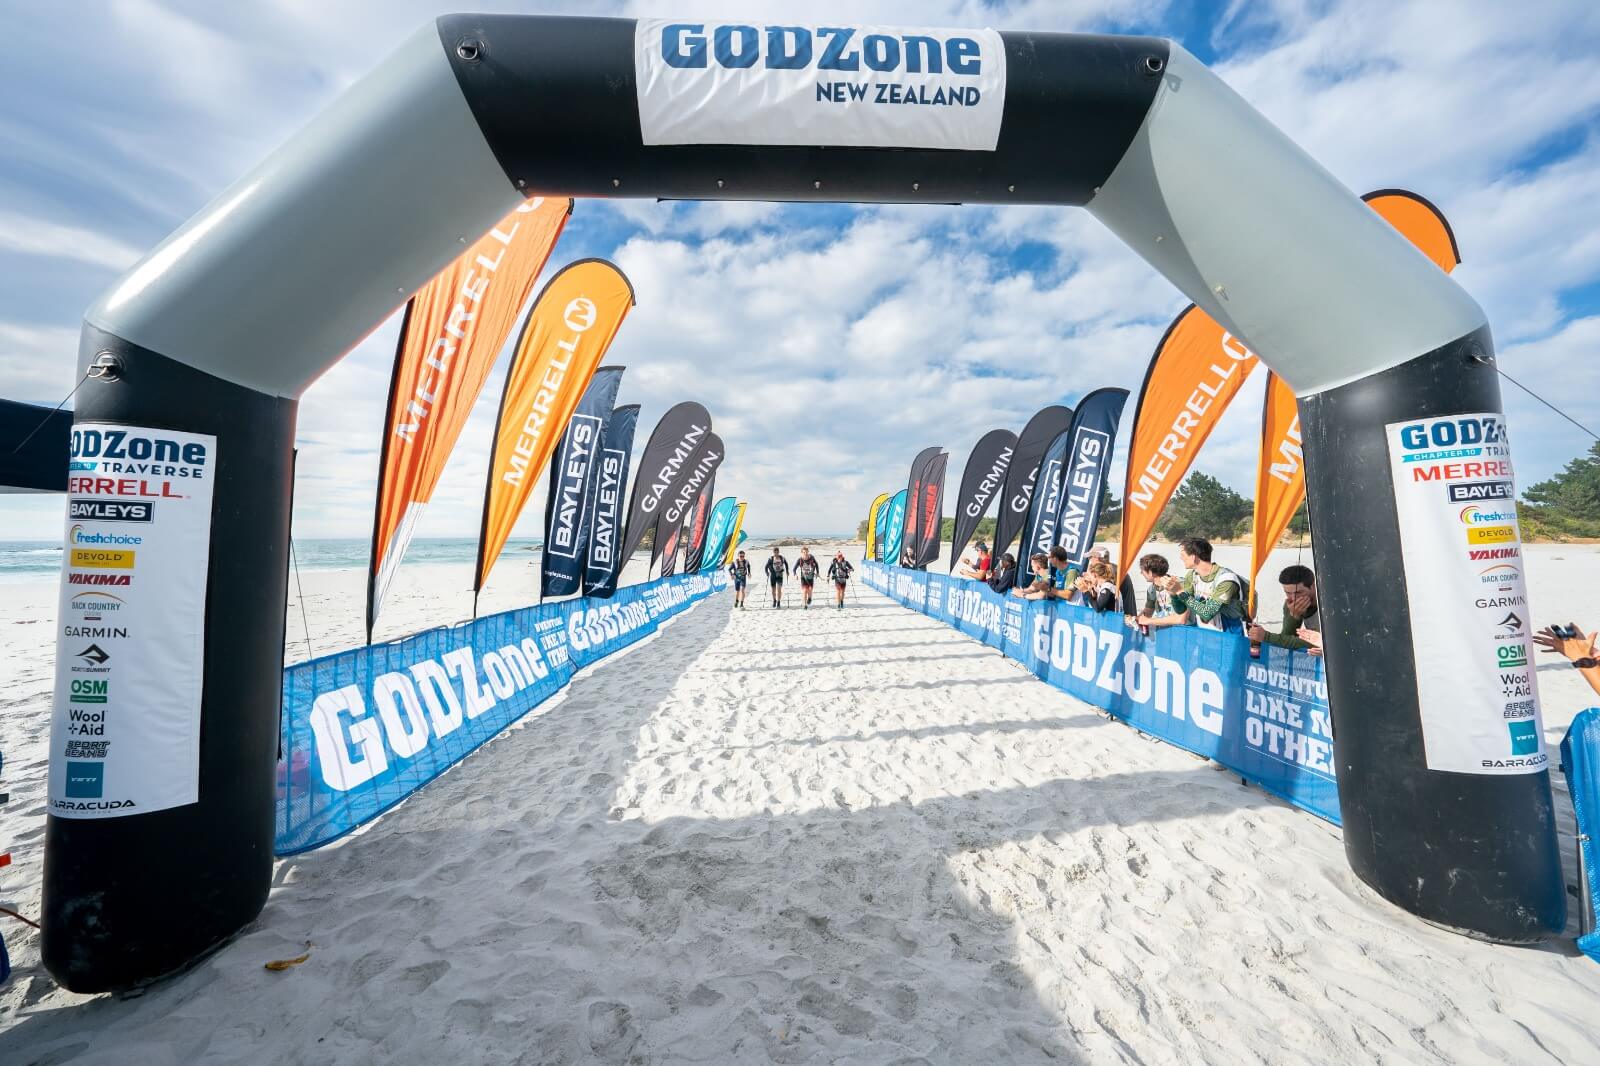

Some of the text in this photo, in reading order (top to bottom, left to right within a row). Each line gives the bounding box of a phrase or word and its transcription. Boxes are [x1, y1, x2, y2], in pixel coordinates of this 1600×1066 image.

[661, 24, 982, 75] GODZone
[816, 82, 981, 106] NEW ZEALAND
[395, 221, 521, 445] MERRELL
[503, 334, 581, 488] MERRELL
[1128, 360, 1238, 511] MERRELL
[1401, 417, 1509, 450] GODZ
[70, 430, 207, 465] ODZone
[1413, 451, 1463, 461] CHAPTER
[102, 462, 203, 478] TRAVERSE
[641, 424, 704, 513] GARMIN
[1413, 461, 1514, 482] MERRE
[68, 477, 183, 498] ERRELL
[556, 423, 592, 548] BAYLEYS
[665, 450, 719, 523] GARMIN
[966, 446, 1014, 518] GARMIN
[1059, 437, 1101, 555] BAYLEYS
[71, 503, 146, 519] BAYLEYS
[594, 457, 617, 563] BAYLEYS
[76, 532, 142, 545] freshchoice
[77, 552, 122, 561] DEVOLD
[1469, 548, 1519, 561] YAKIMA
[68, 573, 131, 586] YAKIMA
[88, 602, 120, 611] COUNTRY
[1475, 595, 1526, 609] GARMIN
[64, 625, 127, 638] GARMIN
[1497, 644, 1526, 659] OSM
[1033, 613, 1224, 737] GODZone
[1246, 664, 1328, 699] ADVENTU
[1501, 672, 1529, 685] Wool
[71, 679, 108, 695] OSM
[69, 710, 105, 722] Wool
[310, 637, 548, 792] GODZone
[1245, 688, 1334, 740] LIKE N
[67, 740, 110, 750] SPORT
[1481, 753, 1548, 768] BARRACUD
